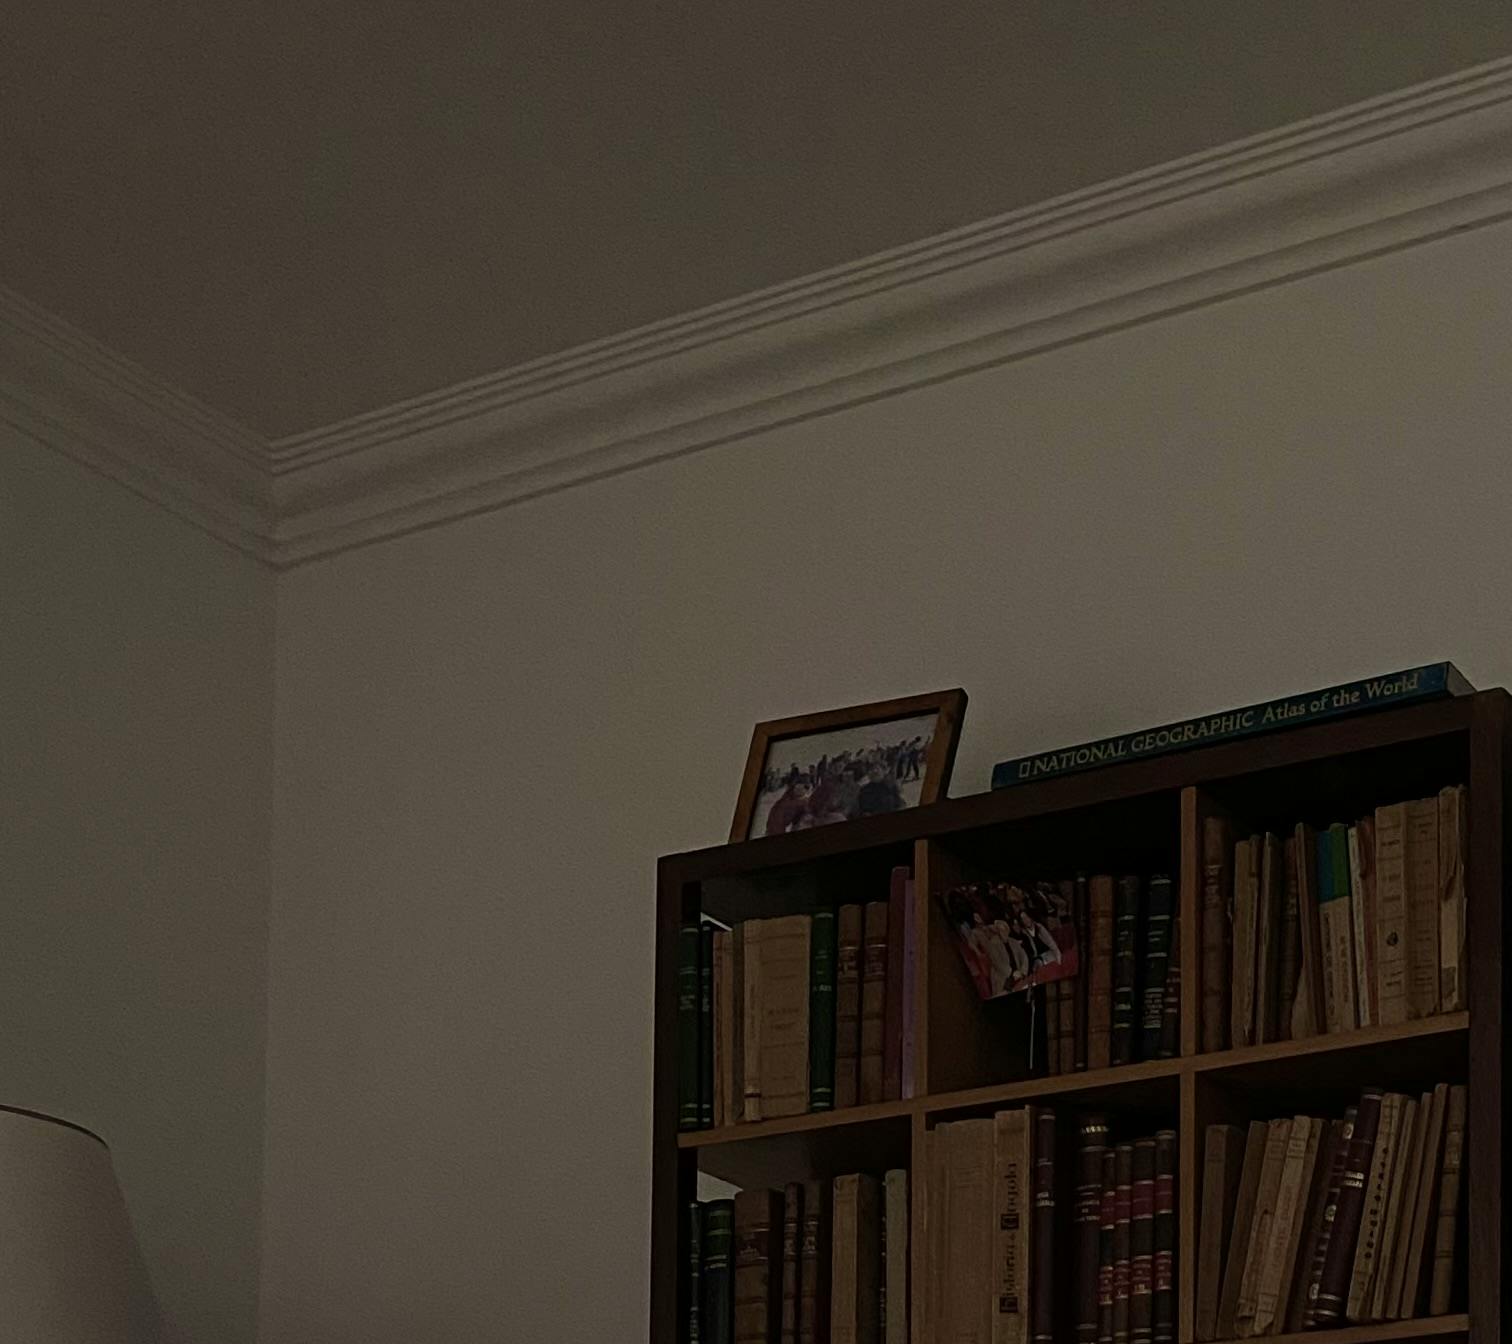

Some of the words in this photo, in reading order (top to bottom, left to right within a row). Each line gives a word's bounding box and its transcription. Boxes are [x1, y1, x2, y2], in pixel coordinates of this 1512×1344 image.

[1031, 741, 1126, 777] NATIONAL
[1130, 710, 1254, 752] GEOGRAPHIC
[1261, 699, 1305, 724] Atlas
[1310, 692, 1329, 712] of
[1334, 686, 1360, 708] the
[1365, 674, 1418, 701] World
